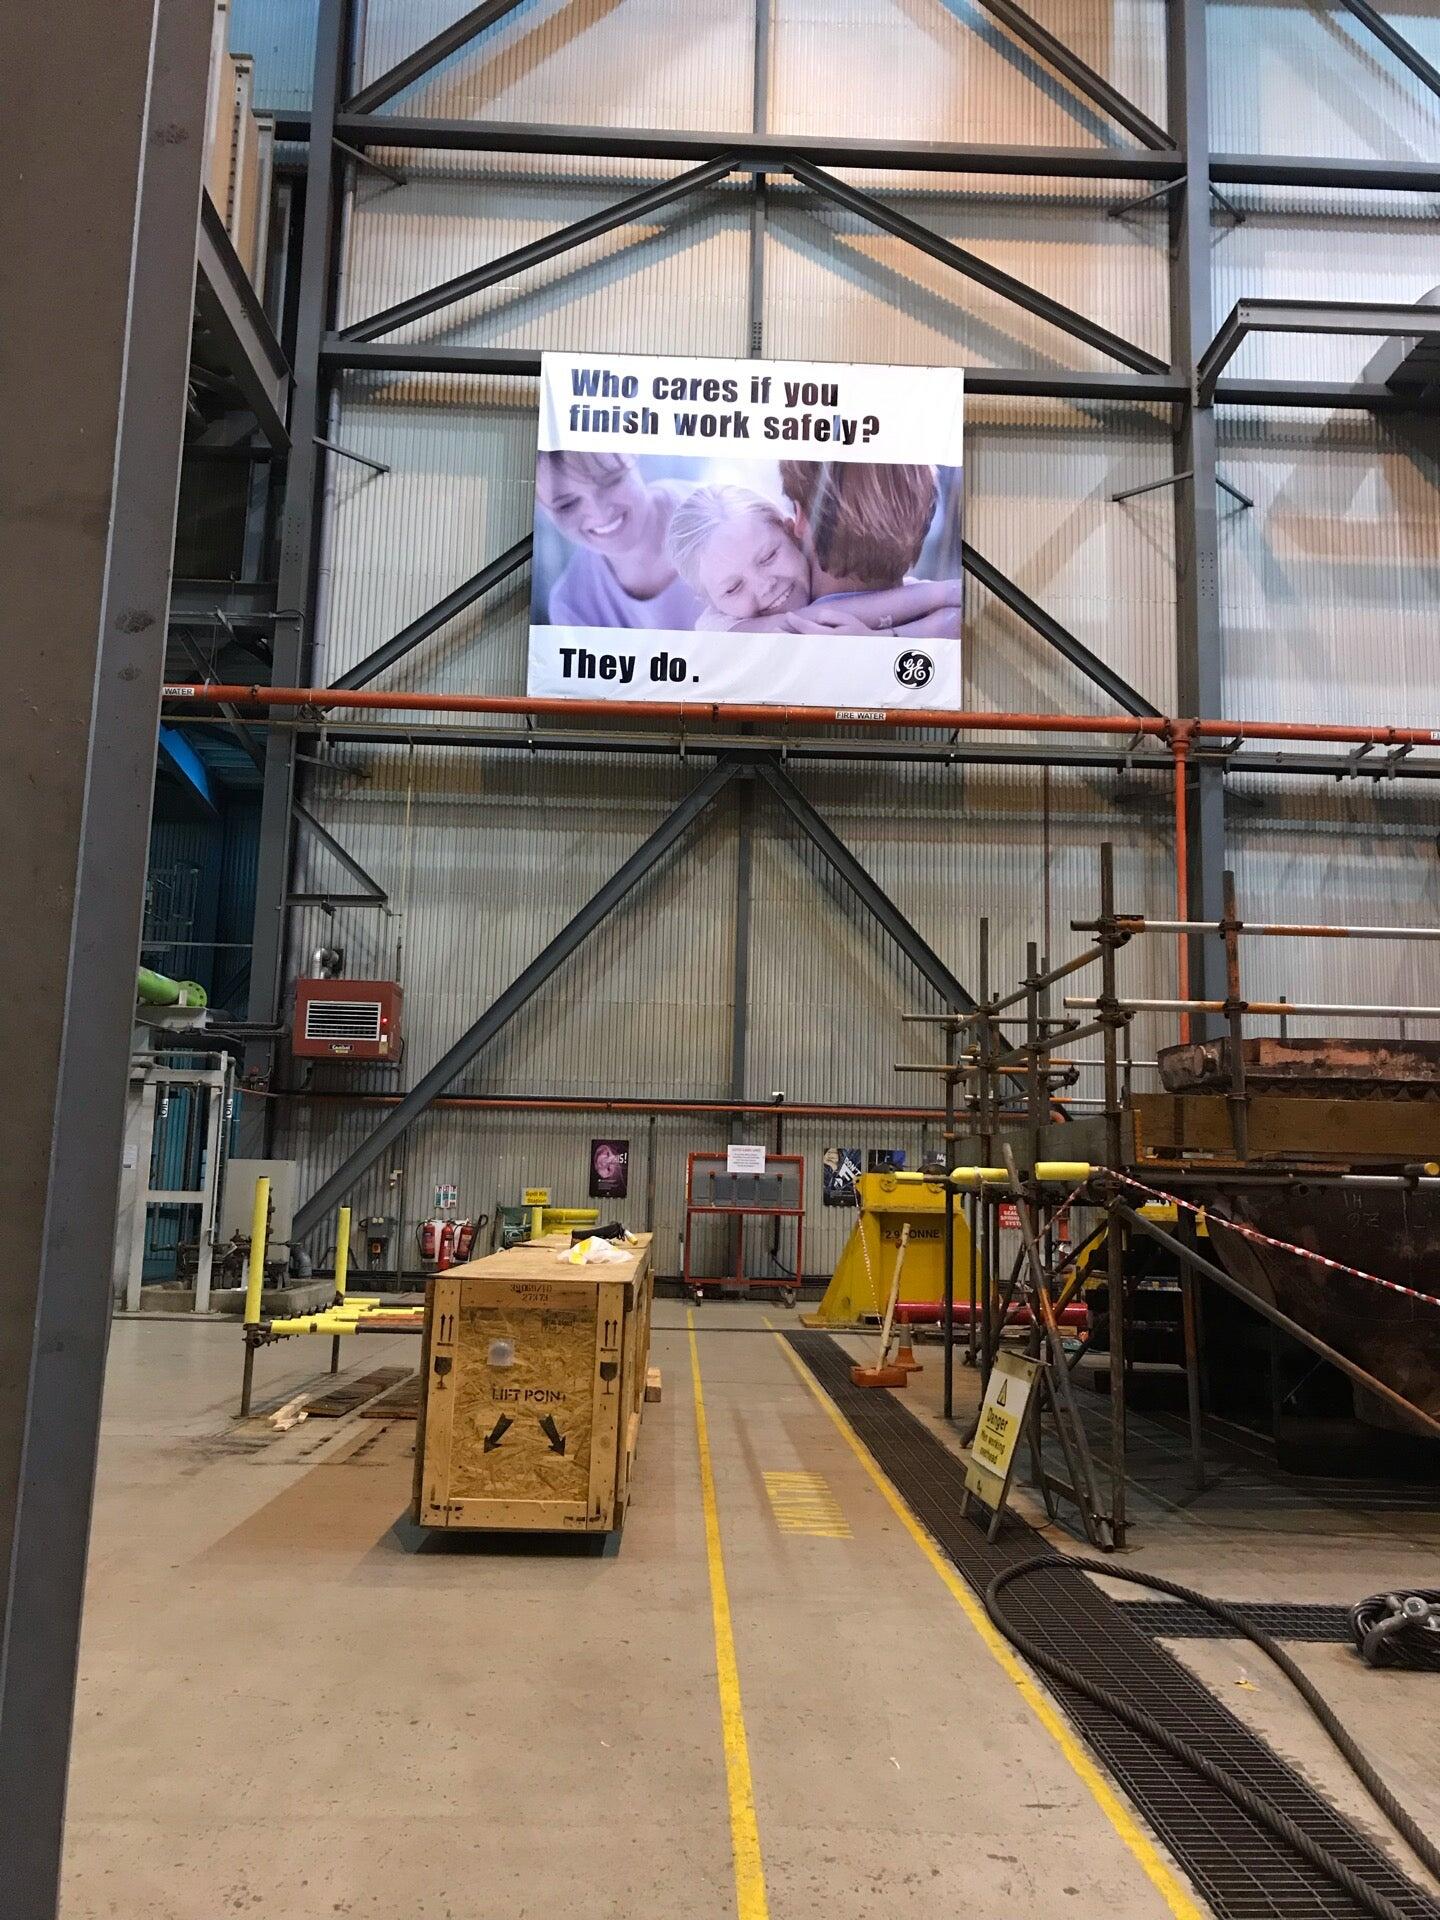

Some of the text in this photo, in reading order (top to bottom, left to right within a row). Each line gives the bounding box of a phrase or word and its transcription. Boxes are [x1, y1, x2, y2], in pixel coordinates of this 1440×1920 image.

[571, 368, 839, 408] Who cares if you
[569, 405, 880, 445] finish work safely?
[559, 648, 700, 683] They do.
[164, 687, 193, 696] WATER
[836, 711, 885, 720] FIRE WATER
[1432, 731, 1440, 739] FI
[845, 1157, 861, 1176] DON'T
[904, 1229, 940, 1238] ONNE
[492, 1387, 521, 1401] LIFT
[987, 1407, 1008, 1431] Danger
[988, 1436, 1005, 1455] working
